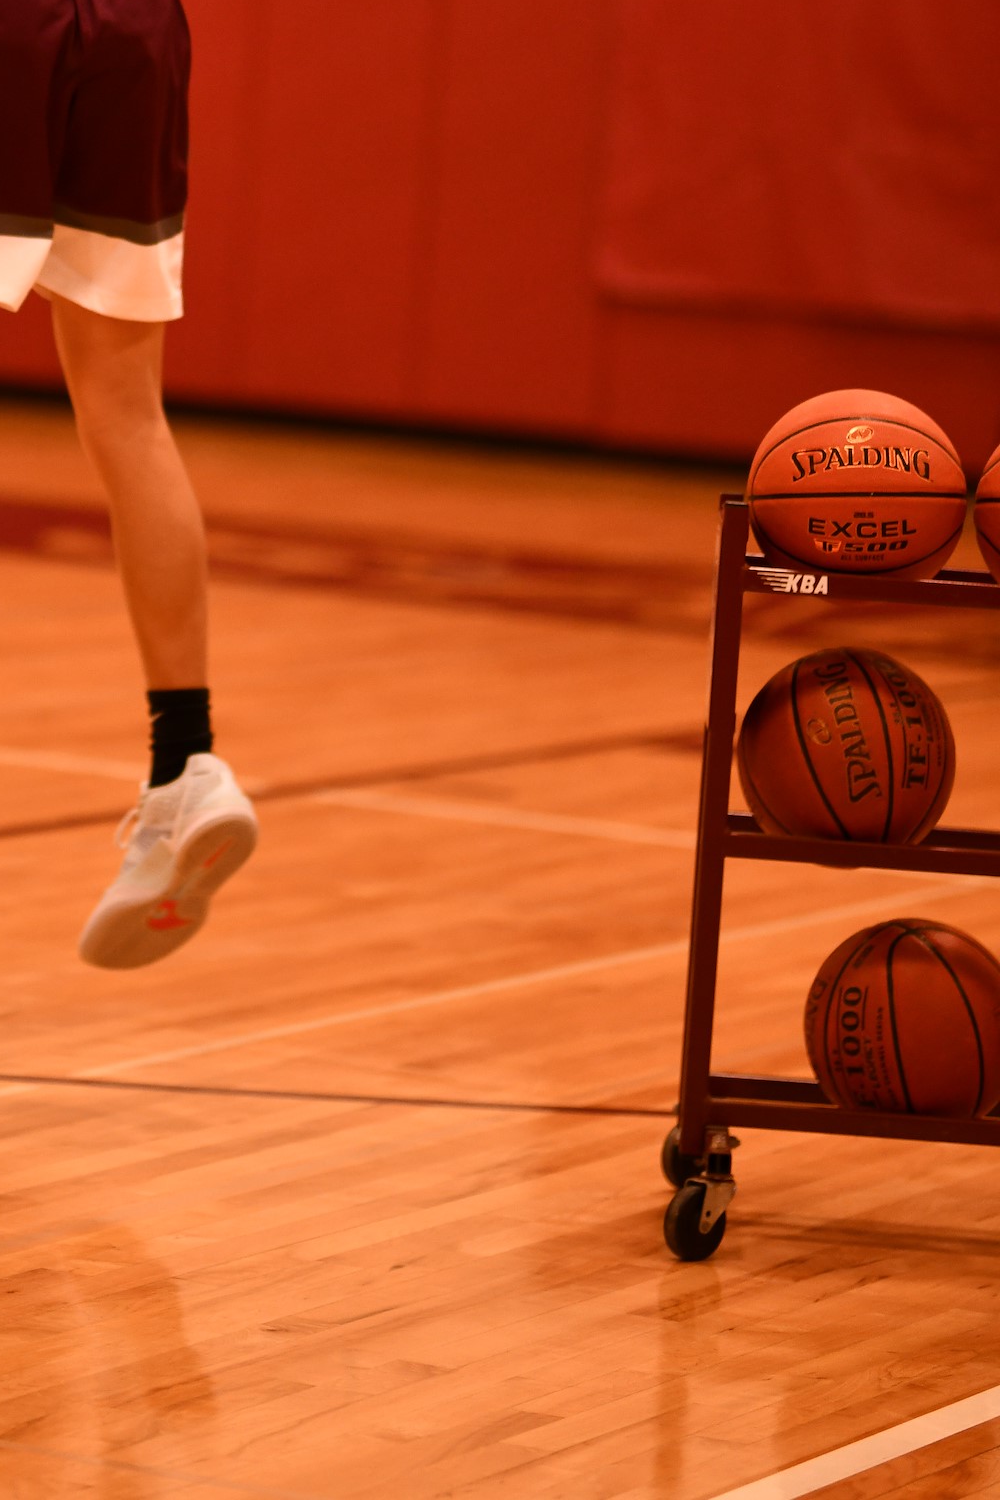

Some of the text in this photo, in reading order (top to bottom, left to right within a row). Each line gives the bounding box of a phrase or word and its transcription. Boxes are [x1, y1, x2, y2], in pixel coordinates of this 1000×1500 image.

[791, 446, 931, 482] SPALDING
[808, 518, 917, 538] EXCEL
[785, 573, 829, 595] KBA
[813, 661, 882, 804] SPALDING
